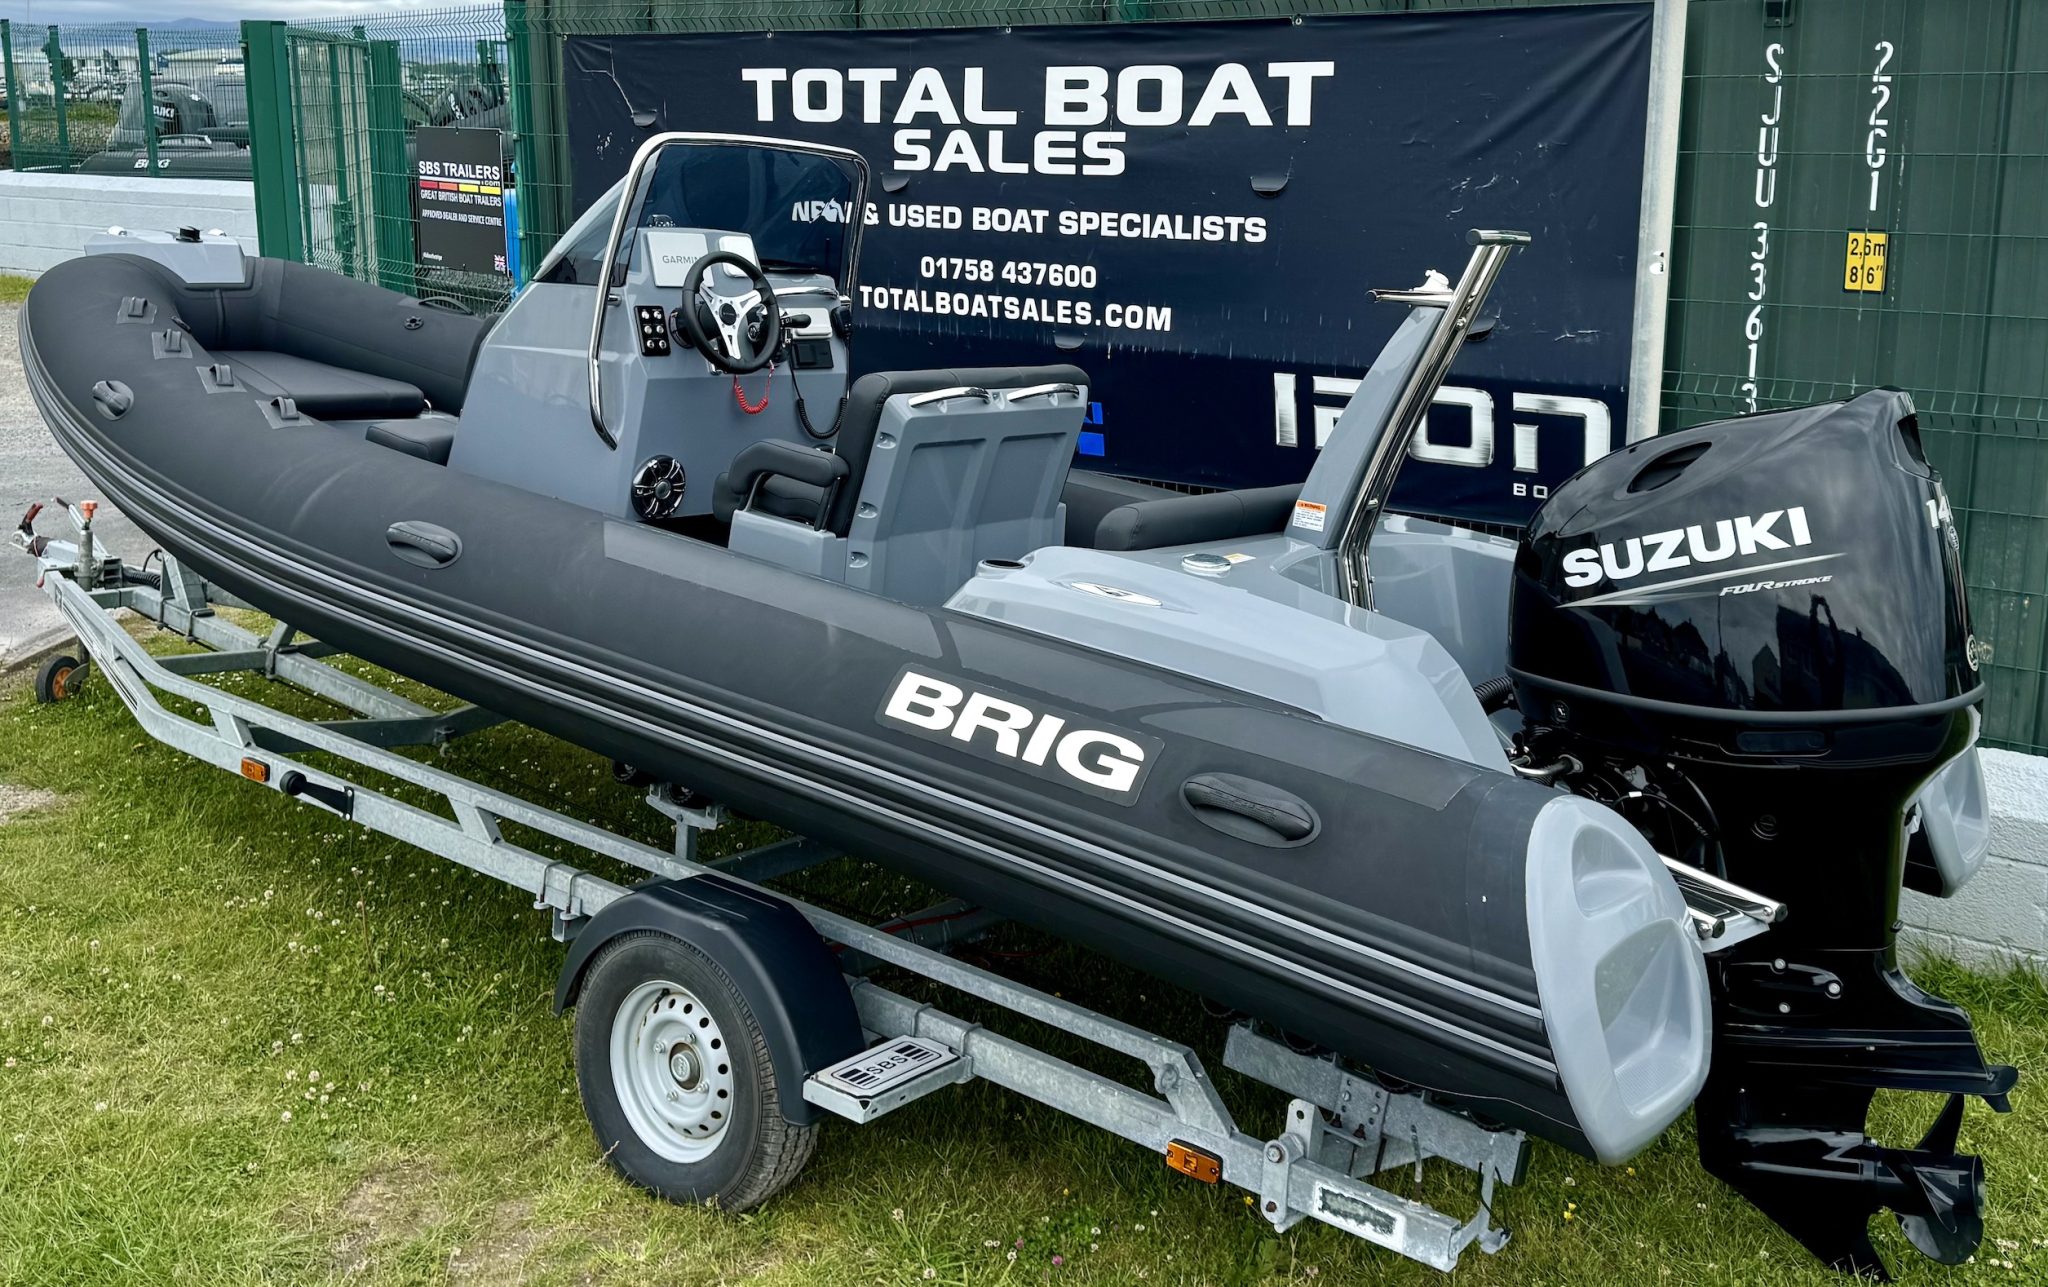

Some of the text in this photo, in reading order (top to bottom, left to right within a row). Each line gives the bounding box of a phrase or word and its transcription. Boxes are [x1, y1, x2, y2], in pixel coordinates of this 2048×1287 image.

[741, 61, 1335, 127] TOTAL BOAT
[1755, 43, 1784, 208] SJUU
[1866, 41, 1894, 211] 22G1
[419, 160, 500, 180] SBS TRAILERS
[893, 130, 1126, 176] SALES
[420, 189, 502, 207] GREAT BRITISH BOAT TRAILERS
[863, 202, 879, 226] &
[888, 203, 962, 230] USED
[972, 207, 1050, 234] BOAT
[1058, 210, 1267, 243] SPECIALISTS
[920, 256, 1097, 289] 01758 437600
[859, 285, 1172, 331] TOTALBOATSALES.COM
[1562, 506, 1813, 588] SUZUKI
[885, 671, 1145, 793] BRIG
[866, 1055, 908, 1075] SBS
